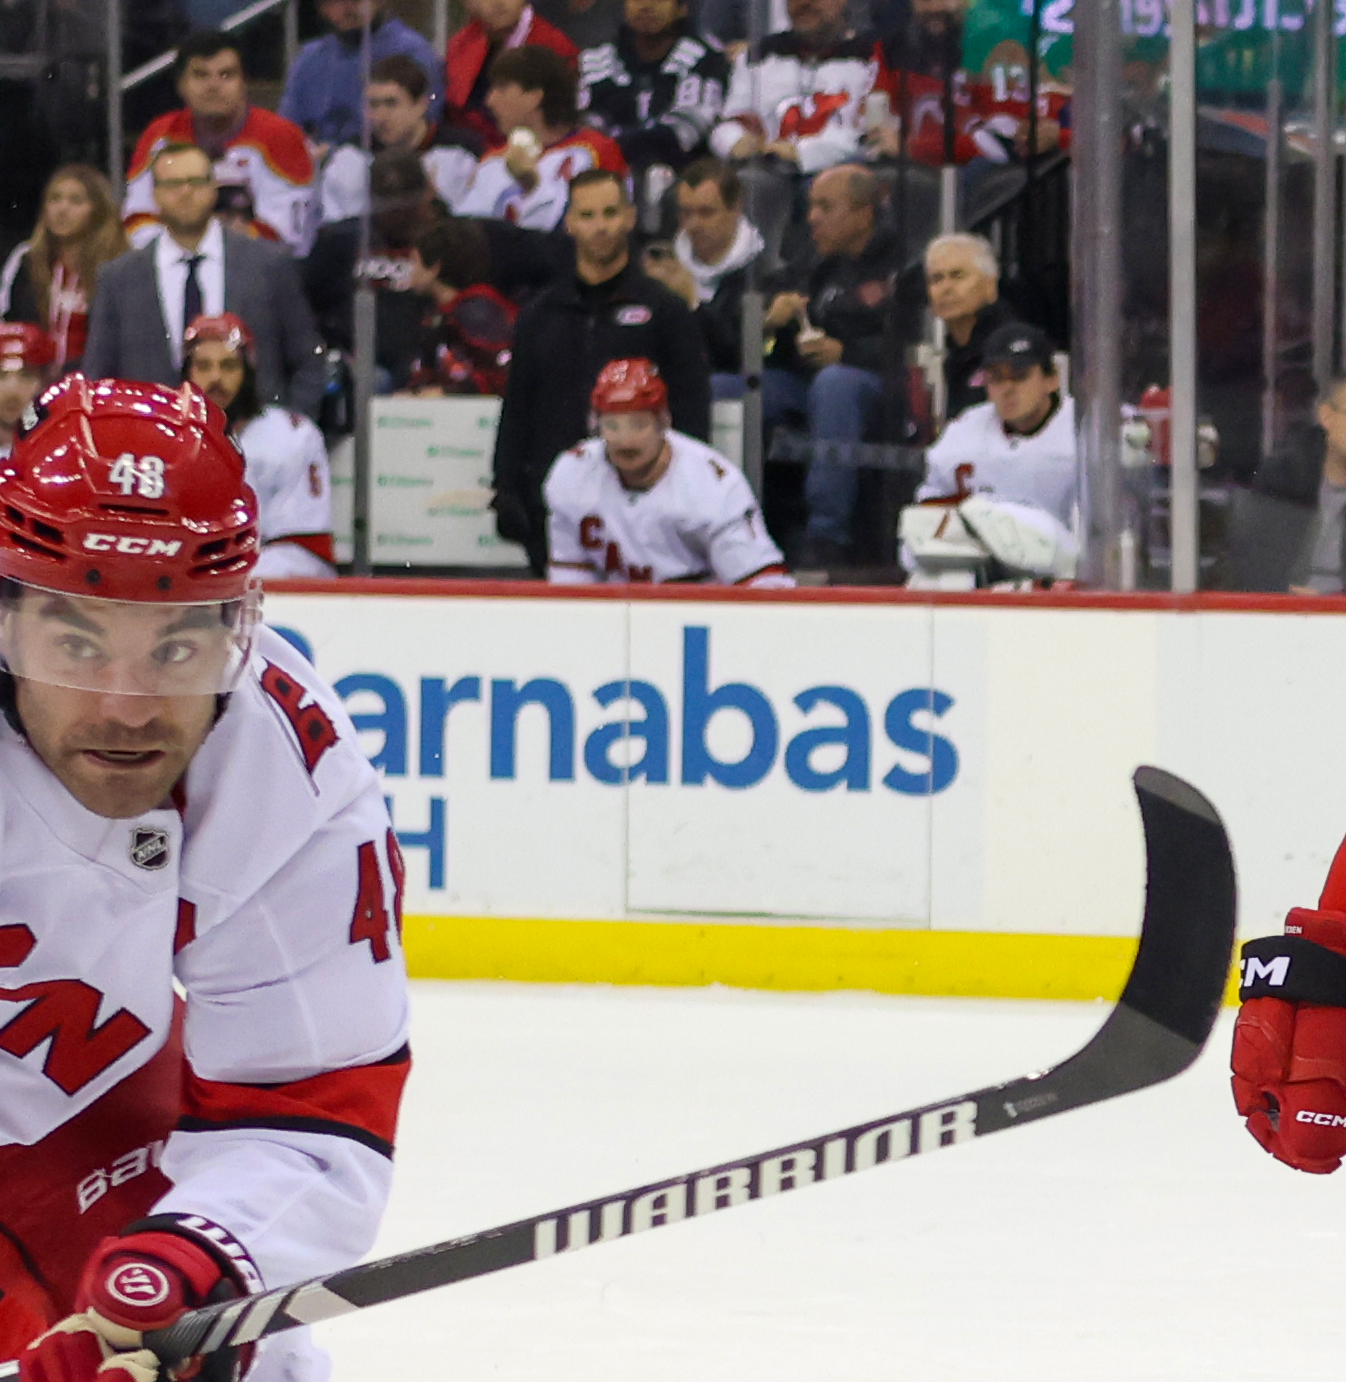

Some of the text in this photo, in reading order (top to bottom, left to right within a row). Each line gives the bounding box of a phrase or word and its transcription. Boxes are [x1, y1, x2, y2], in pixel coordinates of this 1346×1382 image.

[109, 452, 165, 499] 48
[83, 533, 183, 557] CCM
[313, 626, 960, 796] arnabas
[534, 1100, 978, 1261] WARRIOR
